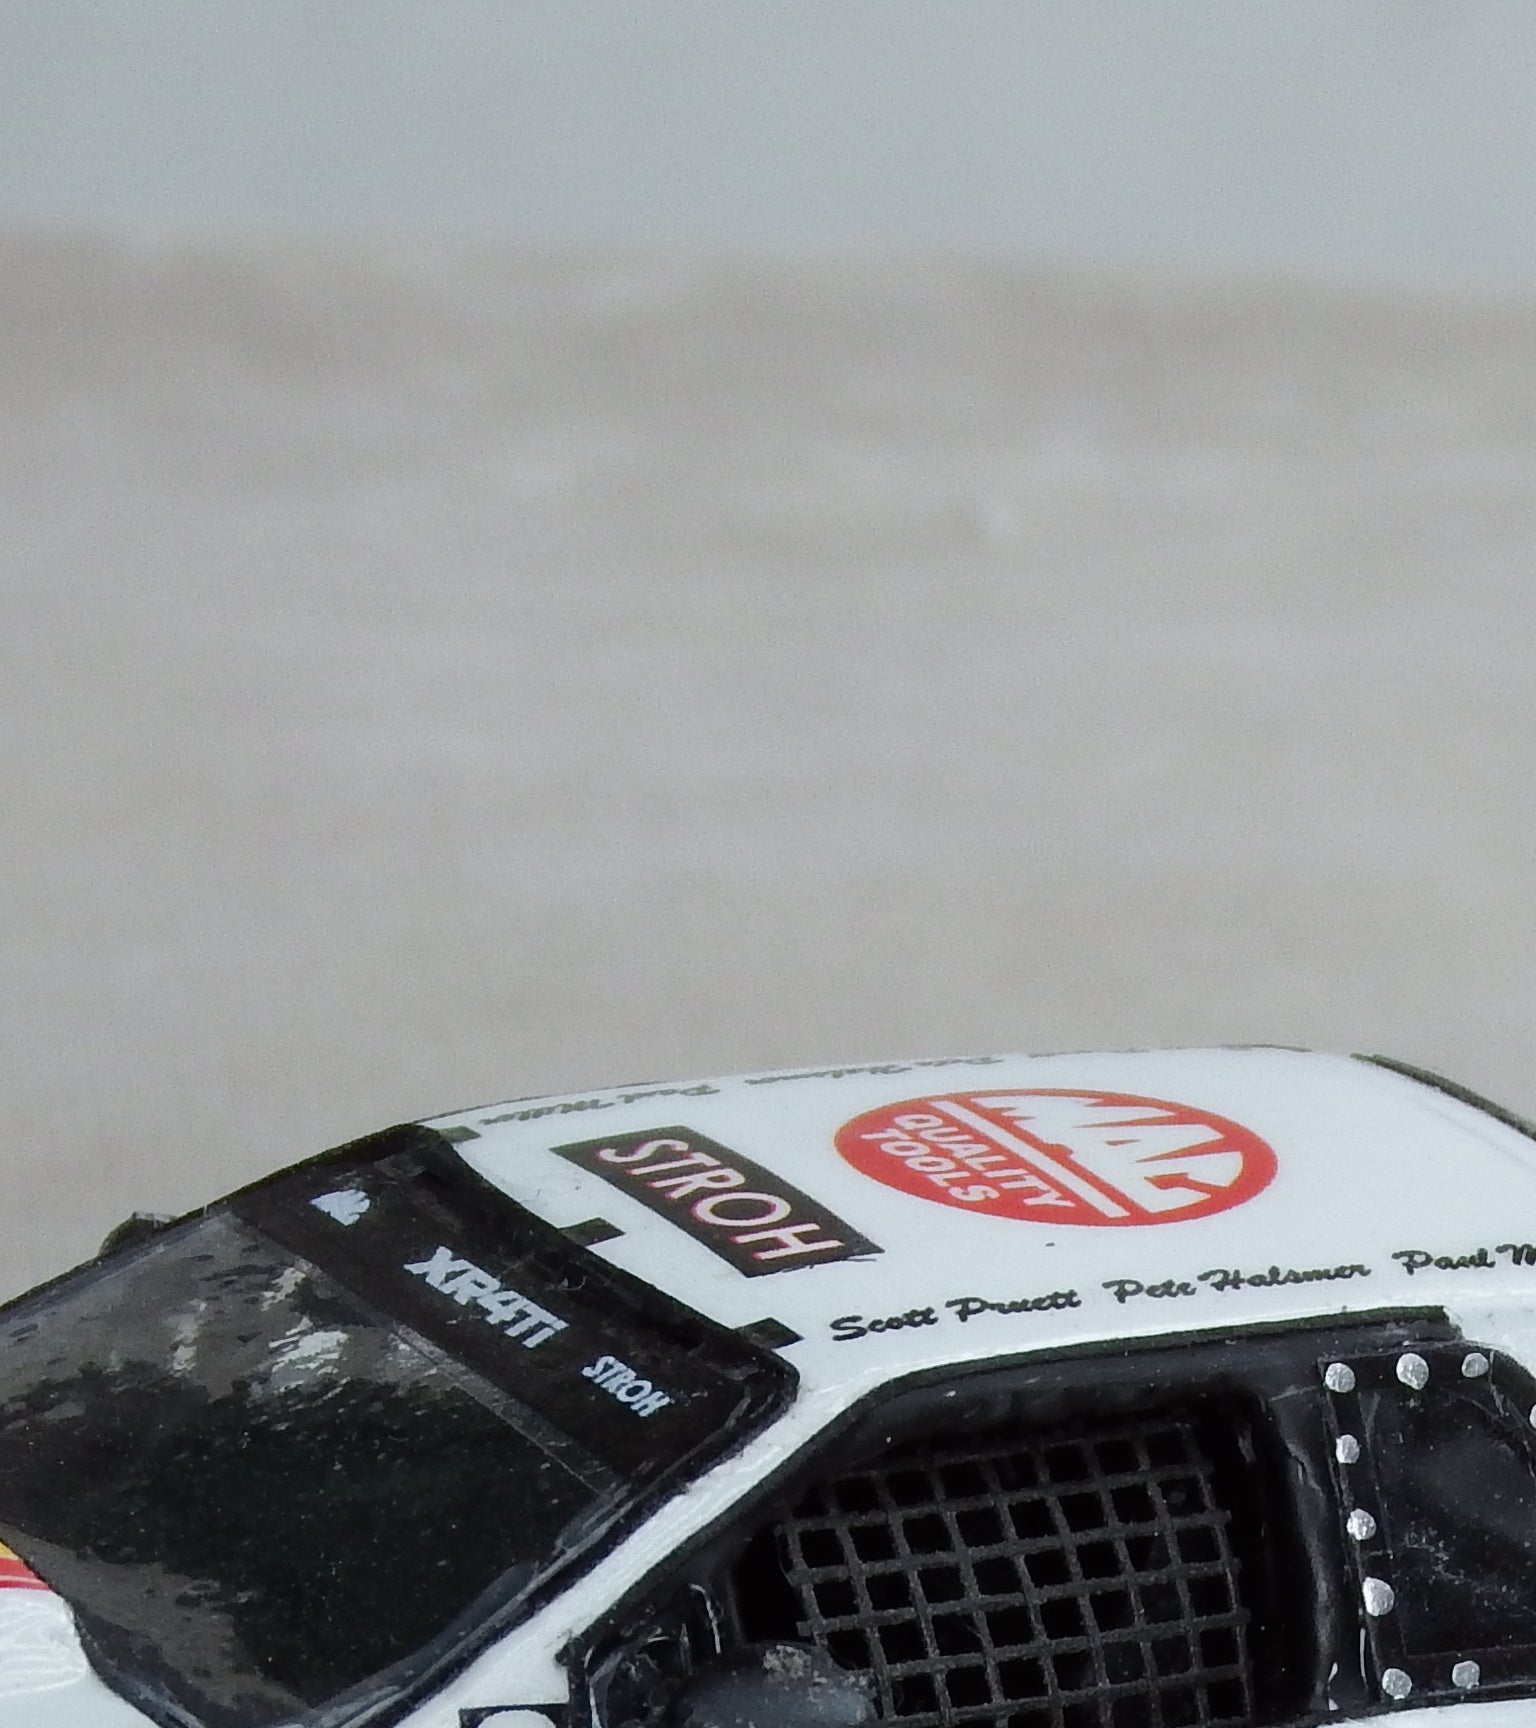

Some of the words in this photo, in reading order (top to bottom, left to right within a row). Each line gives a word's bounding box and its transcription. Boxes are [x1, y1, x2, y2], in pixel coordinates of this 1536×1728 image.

[593, 1138, 846, 1263] STROH
[857, 1127, 1000, 1205] TOOLS
[892, 1112, 1078, 1210] QUALITY
[973, 1095, 1244, 1218] MAC
[402, 1245, 571, 1349] XR4Ti
[581, 1354, 672, 1418] STROH
[829, 1306, 939, 1342] Scott
[944, 1289, 1082, 1323] Pruett
[1101, 1278, 1197, 1304] Pete
[1391, 1247, 1496, 1276] Paul
